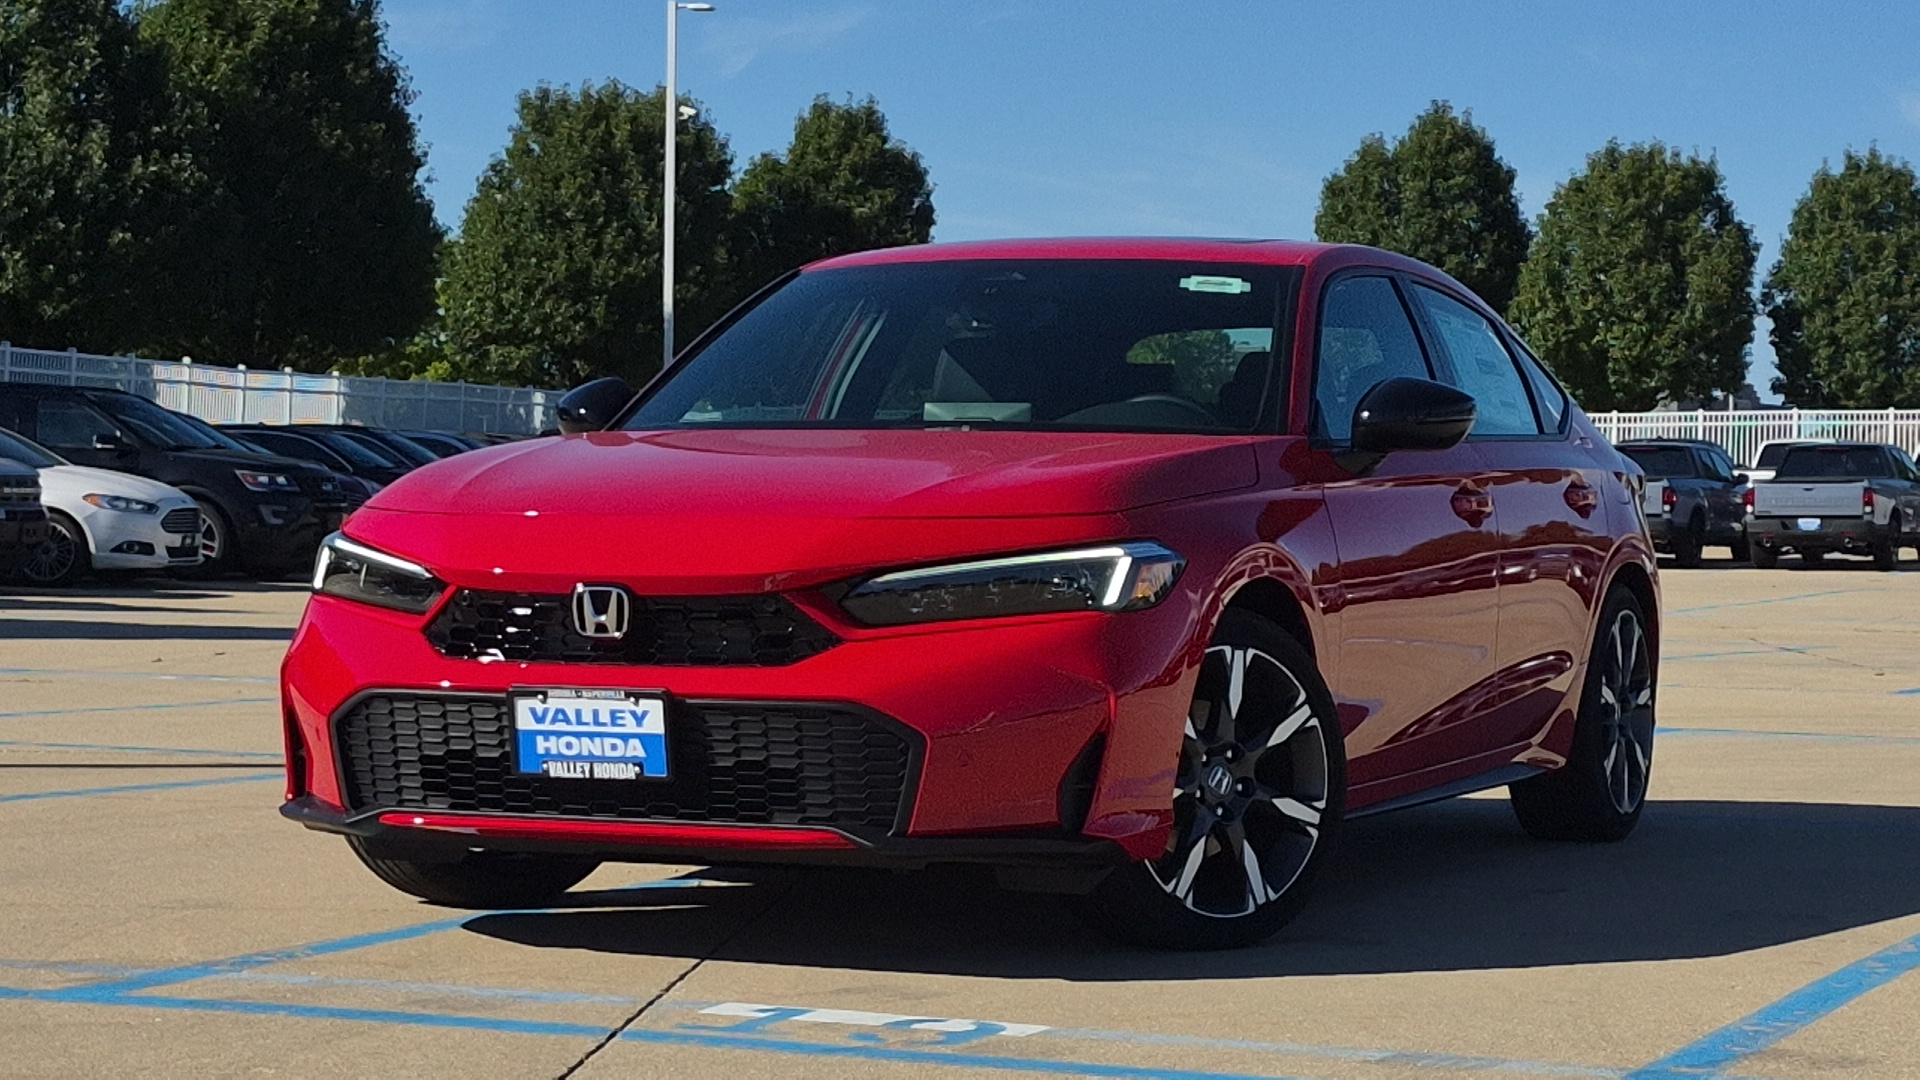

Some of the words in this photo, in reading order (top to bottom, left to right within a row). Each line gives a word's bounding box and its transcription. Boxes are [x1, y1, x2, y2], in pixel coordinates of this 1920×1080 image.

[528, 706, 650, 728] VALLEY
[536, 735, 647, 758] HONDA
[548, 761, 590, 778] VALLEY
[593, 762, 636, 780] HONDA
